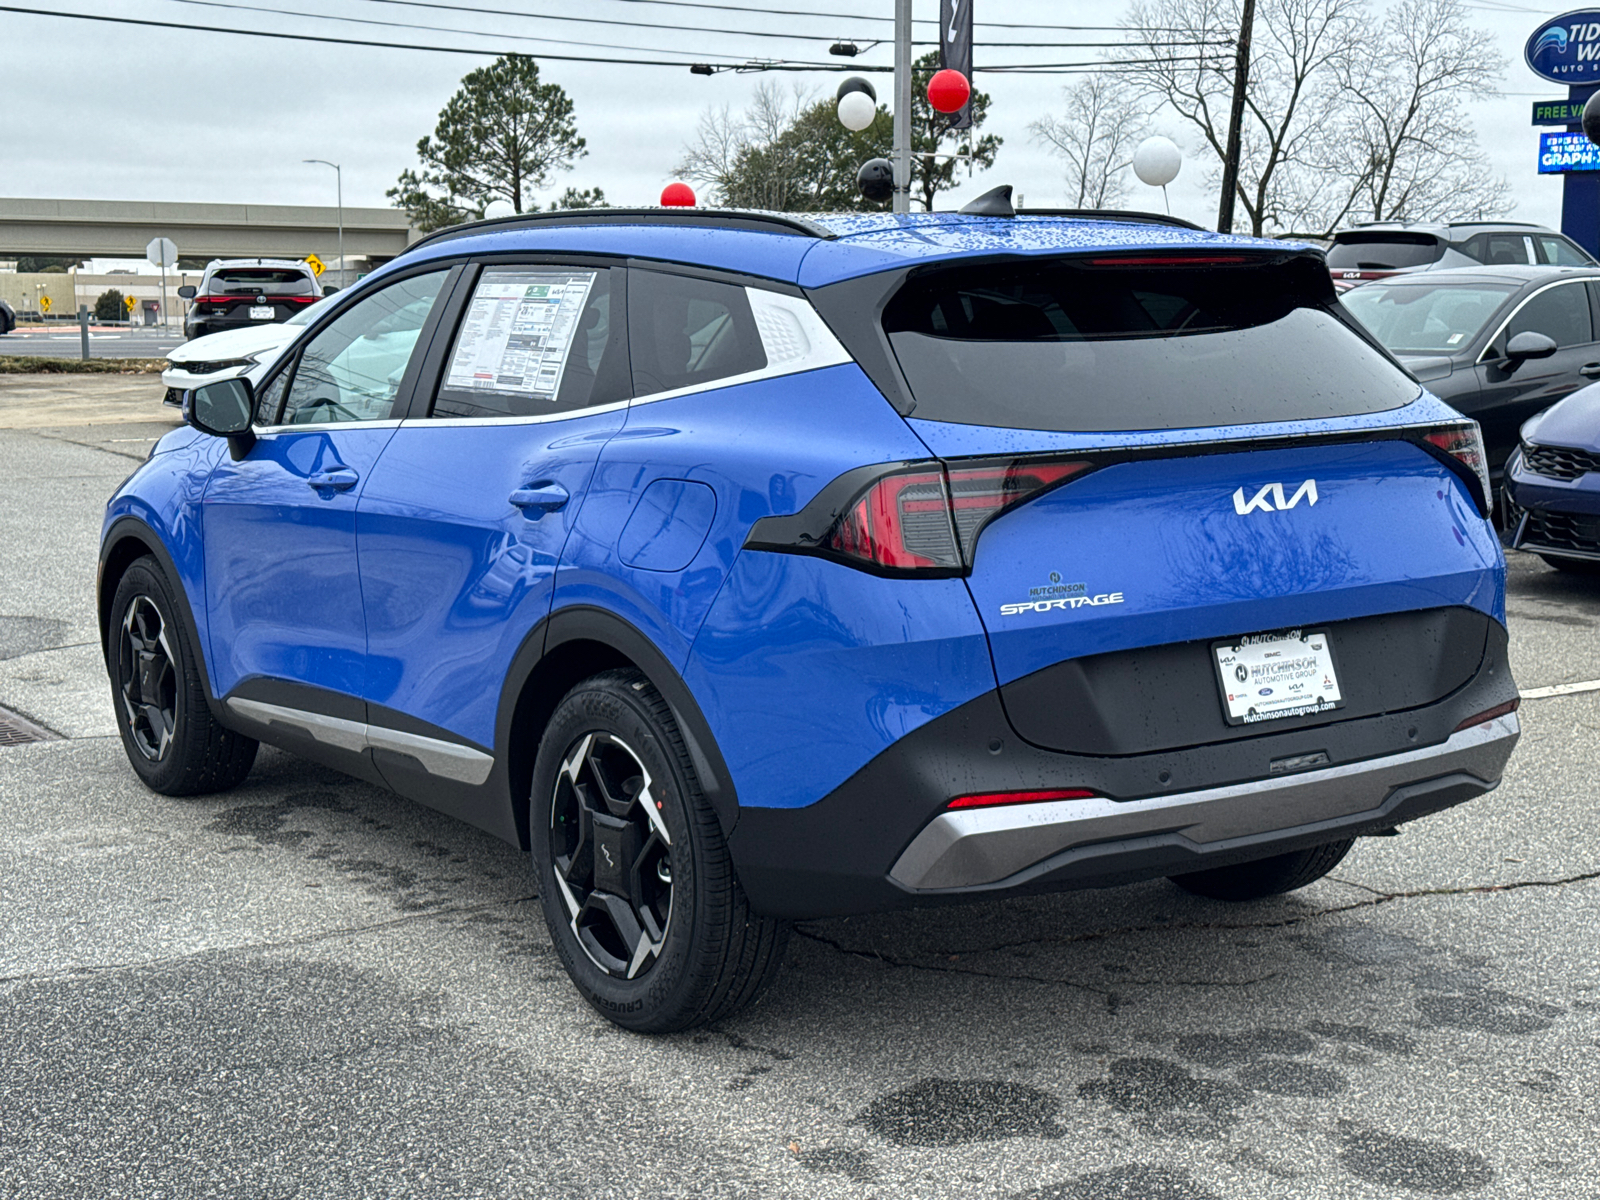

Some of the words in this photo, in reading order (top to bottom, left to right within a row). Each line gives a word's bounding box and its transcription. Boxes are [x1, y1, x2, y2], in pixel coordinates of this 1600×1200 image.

[1553, 64, 1583, 73] AUTO
[1536, 105, 1568, 120] FREE
[1233, 479, 1318, 515] KIA
[1029, 583, 1085, 596] HUTCHINSON
[1000, 592, 1125, 615] SPORTAGE
[1251, 656, 1317, 677] HUTCHINSON
[1254, 672, 1294, 685] AUTOMOTIVE
[1295, 669, 1317, 679] GROUP
[1243, 701, 1336, 723] Hutchinsonautogroup.com
